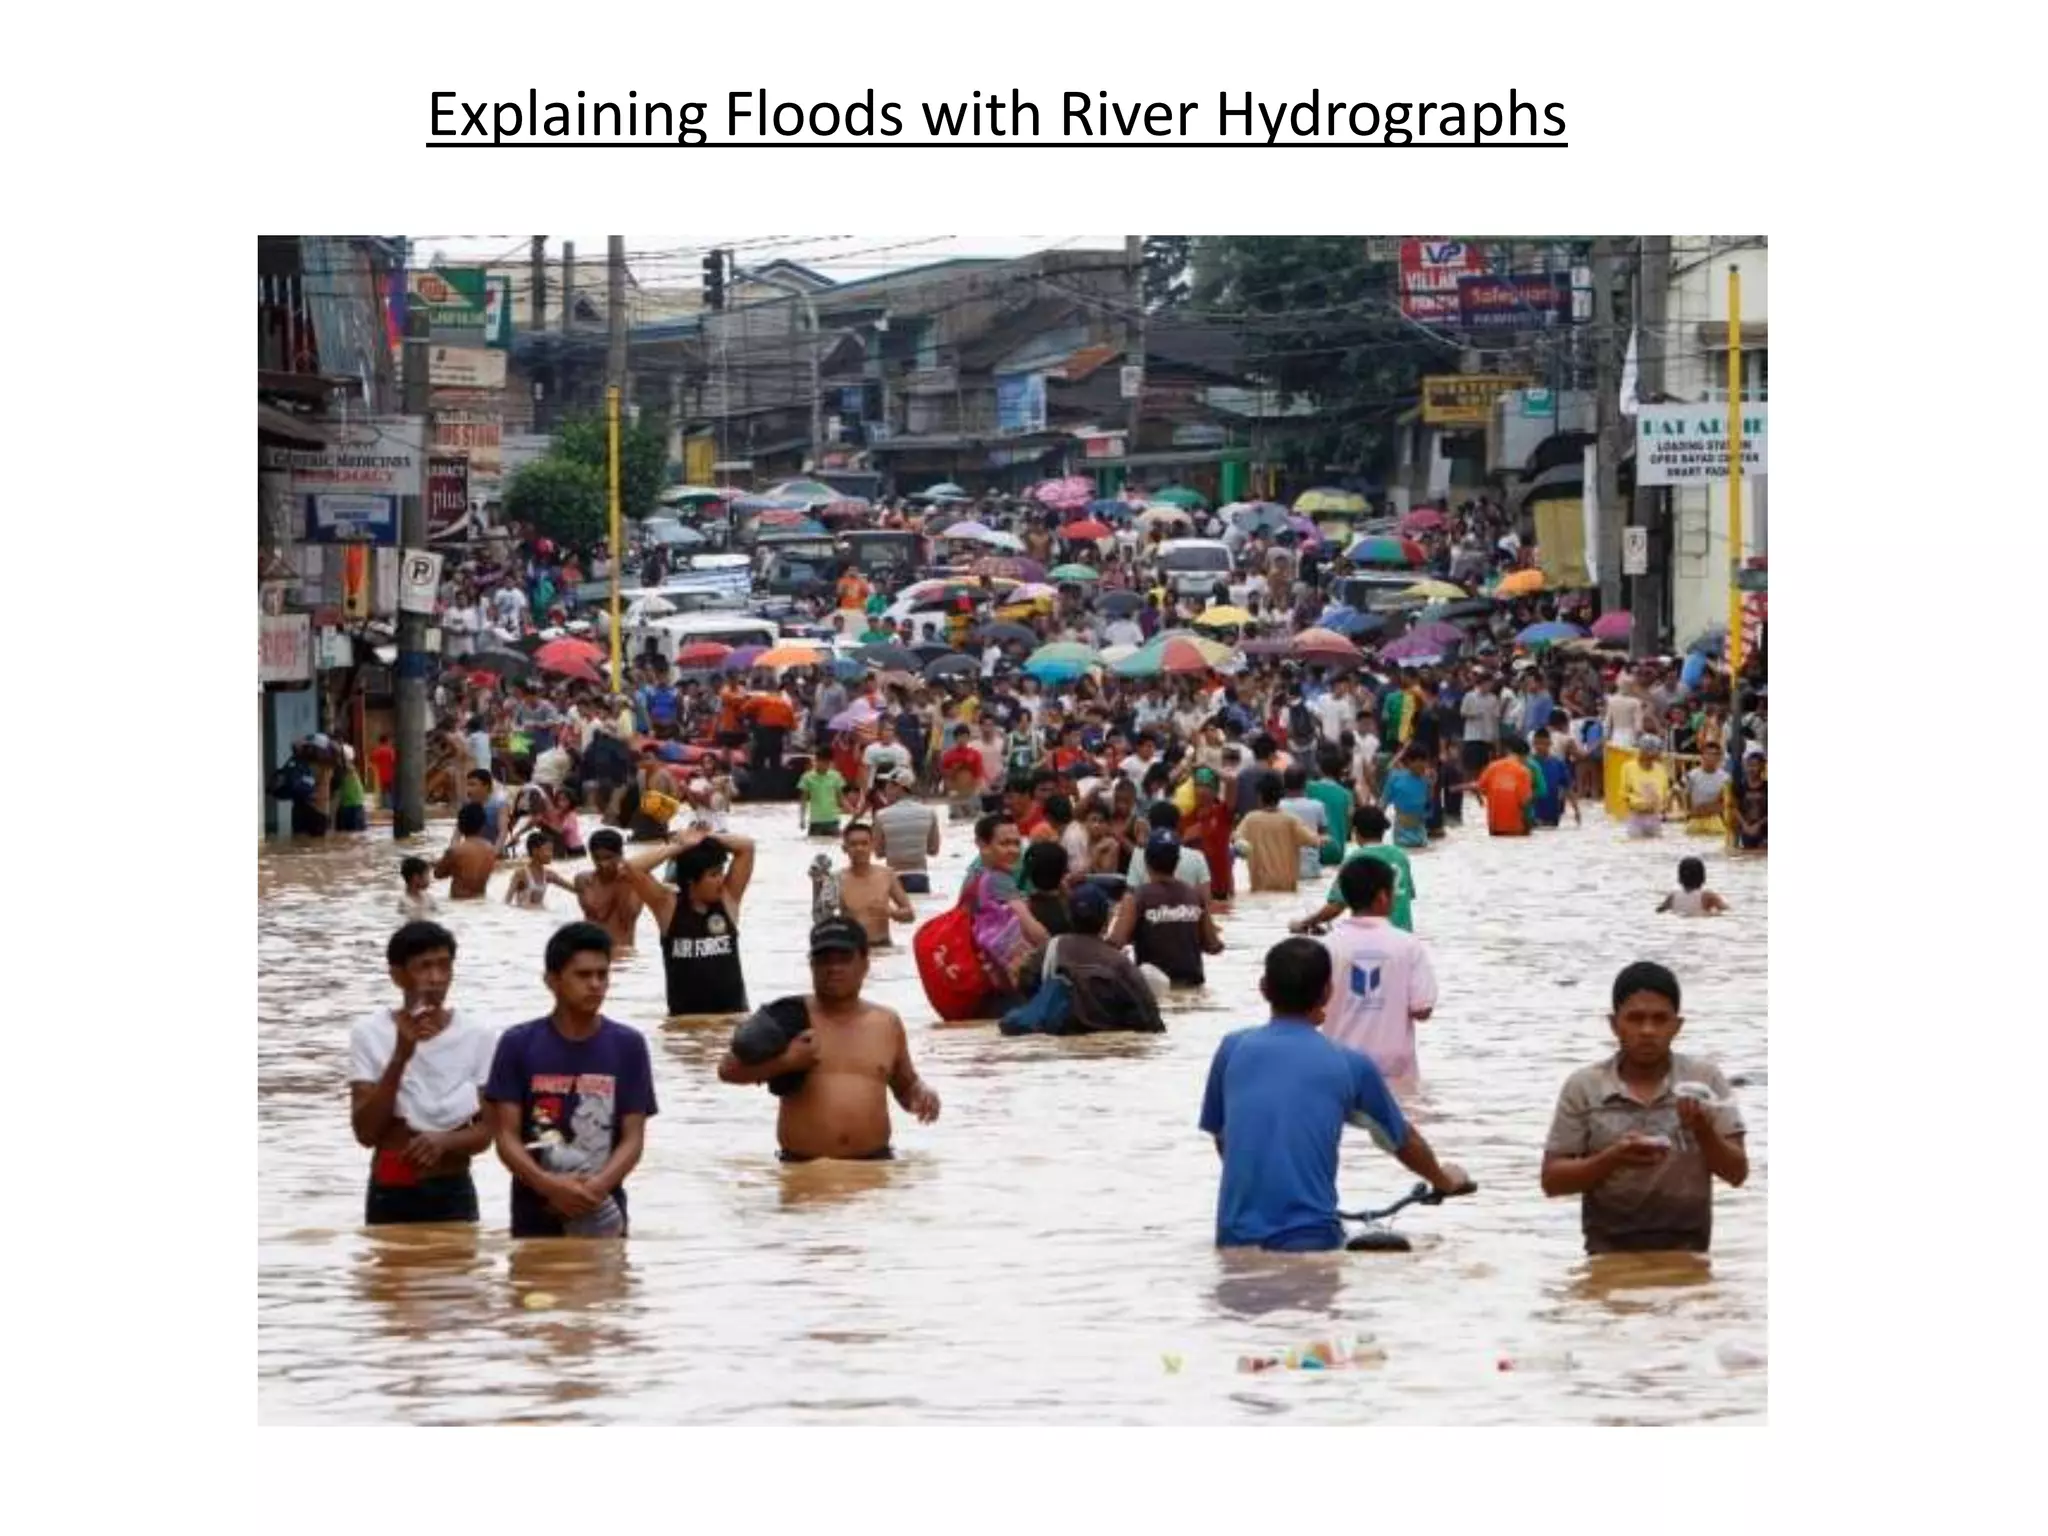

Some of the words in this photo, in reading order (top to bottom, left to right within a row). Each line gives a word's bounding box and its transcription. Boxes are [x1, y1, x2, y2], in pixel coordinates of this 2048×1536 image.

[1706, 440, 1752, 451] STAON
[1718, 451, 1760, 463] CETER
[671, 937, 692, 958] AIR
[695, 935, 733, 957] FORCE
